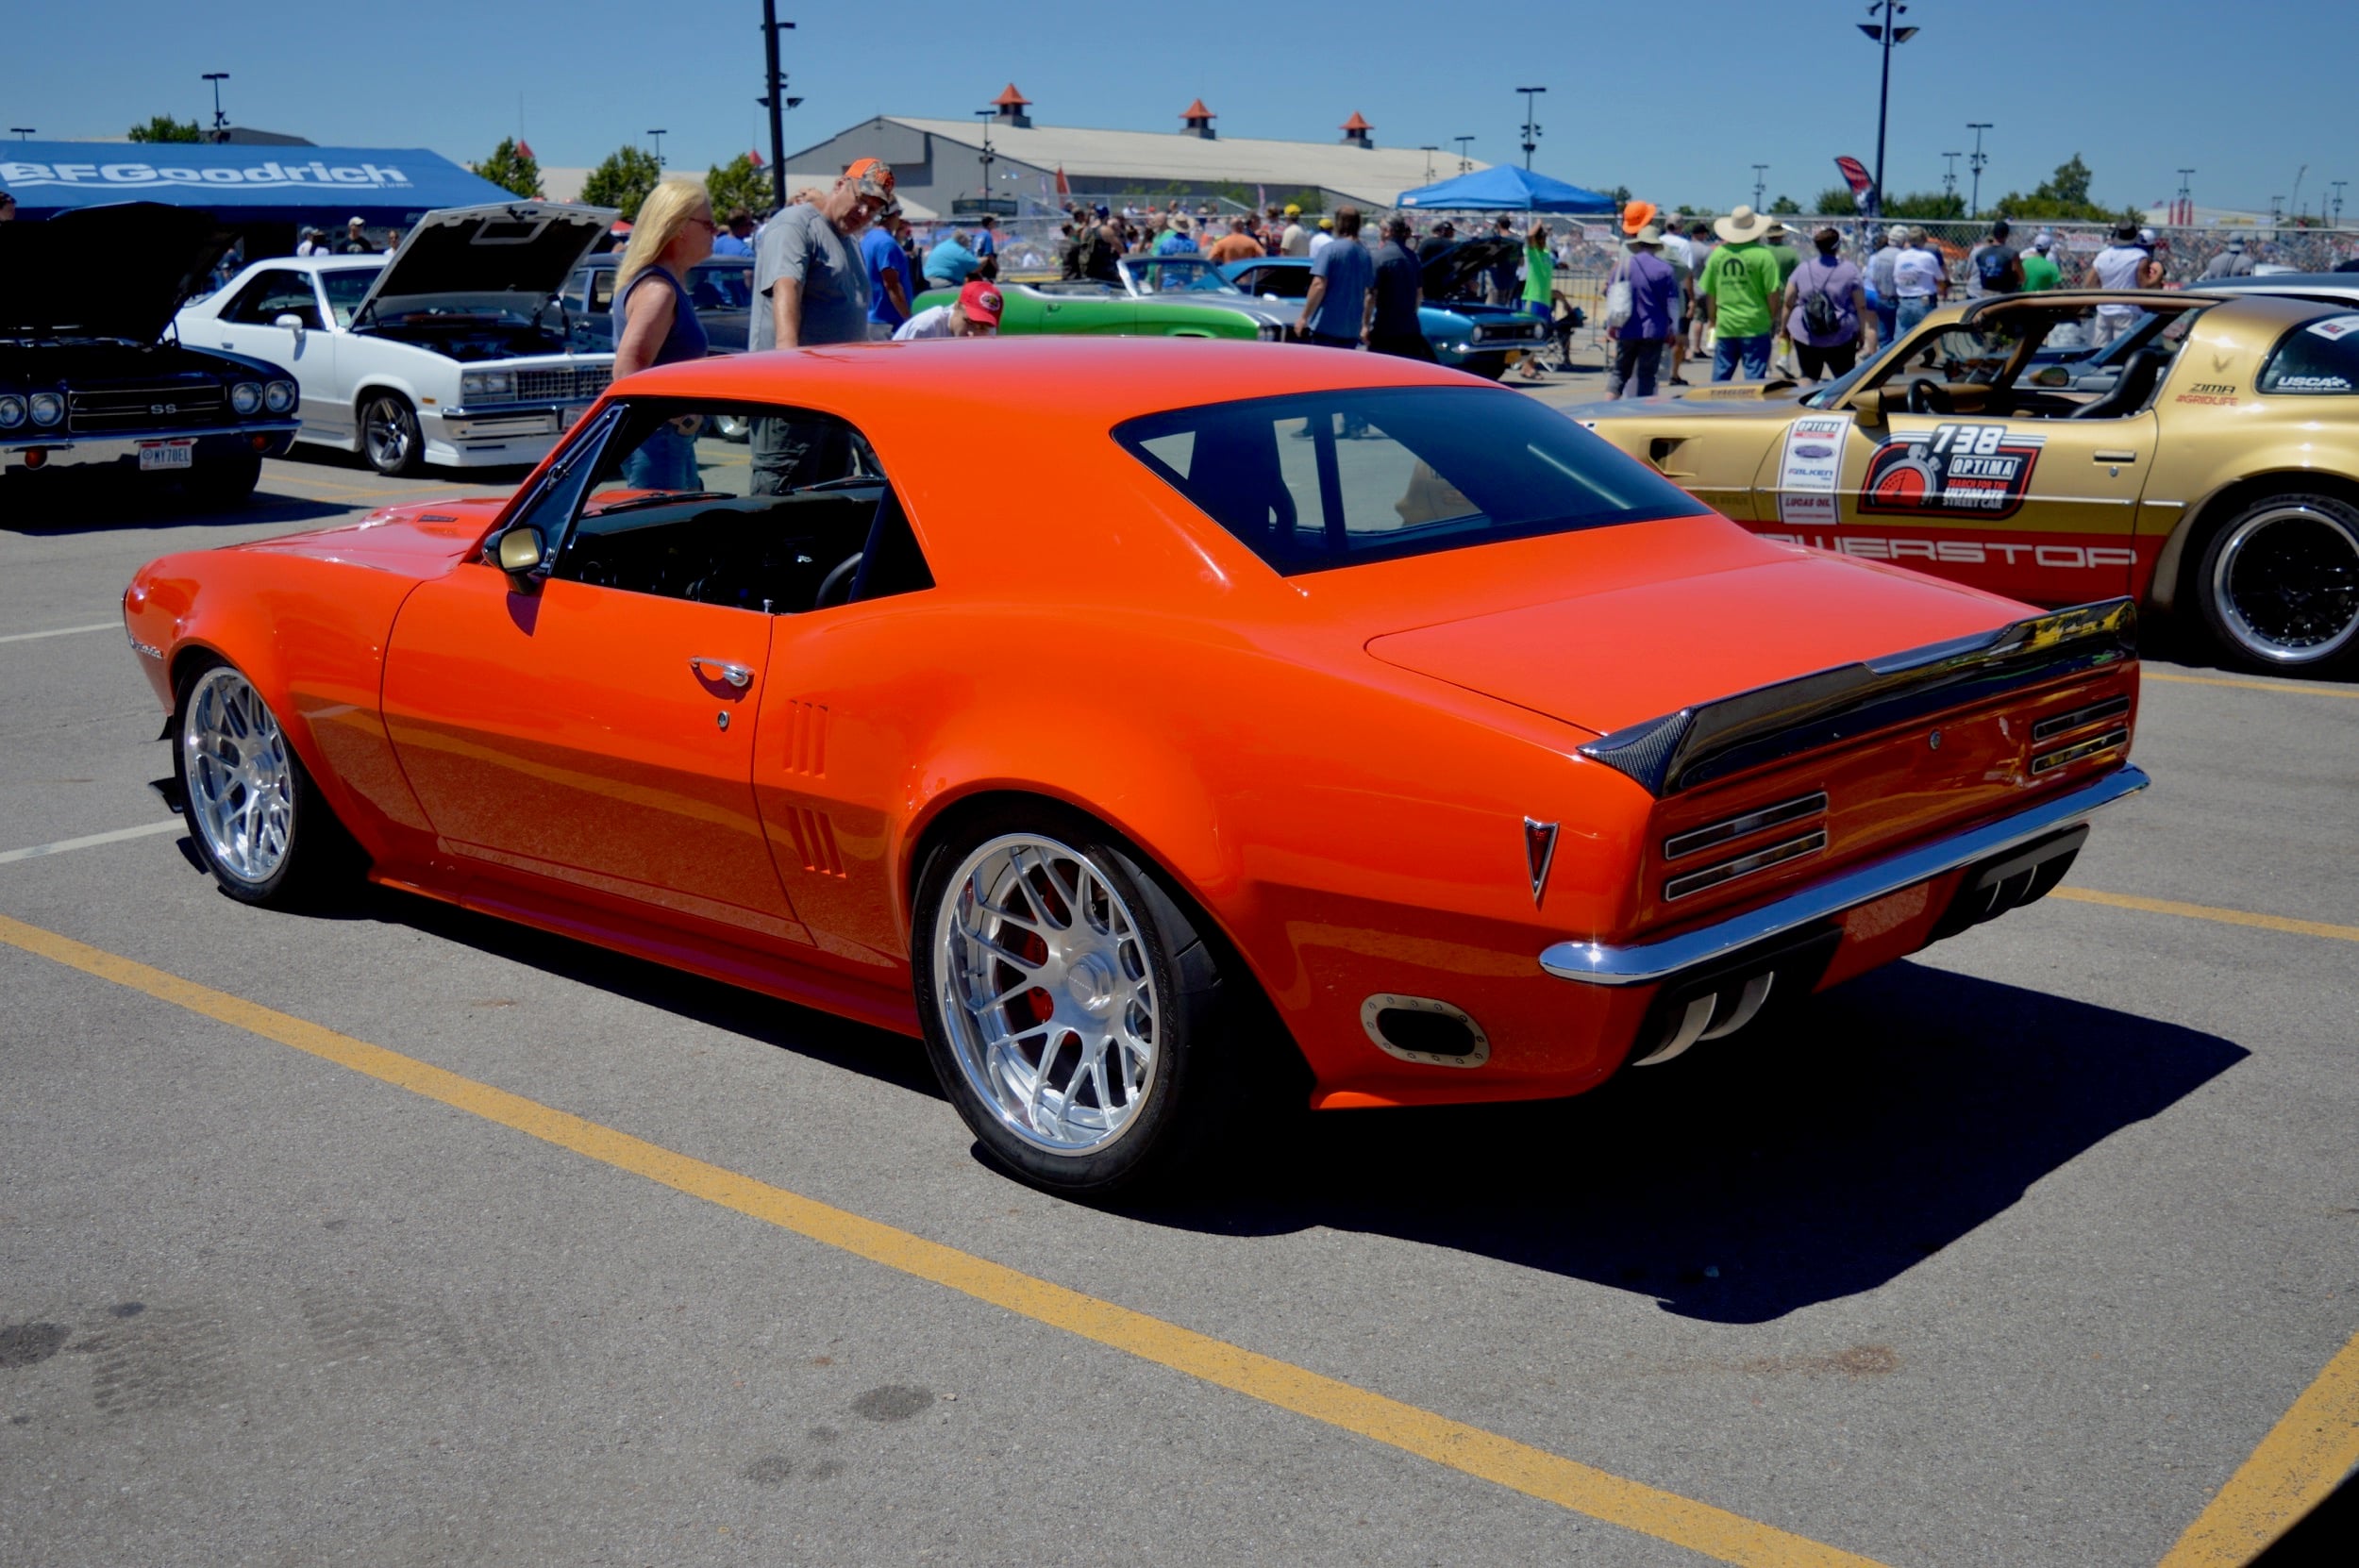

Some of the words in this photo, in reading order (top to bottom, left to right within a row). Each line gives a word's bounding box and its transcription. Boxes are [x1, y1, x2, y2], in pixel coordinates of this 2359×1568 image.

[0, 161, 409, 182] BFGoodrich
[2189, 383, 2236, 393] ZIMA
[2175, 394, 2239, 406] #GRIDLIFE
[151, 404, 176, 414] SS
[1797, 421, 1839, 433] OPTIMA
[1932, 425, 2003, 454] 738
[1952, 459, 2013, 475] OPTIMA
[1949, 479, 1976, 488] SEARCH
[1977, 480, 1993, 489] FOR
[1994, 480, 2009, 491] THE
[1943, 488, 2005, 499] ULTIMATE
[1785, 497, 1814, 508] LUCAS
[1816, 498, 1831, 508] OIL
[1943, 498, 1980, 508] STREET
[1981, 499, 2003, 509] CAR
